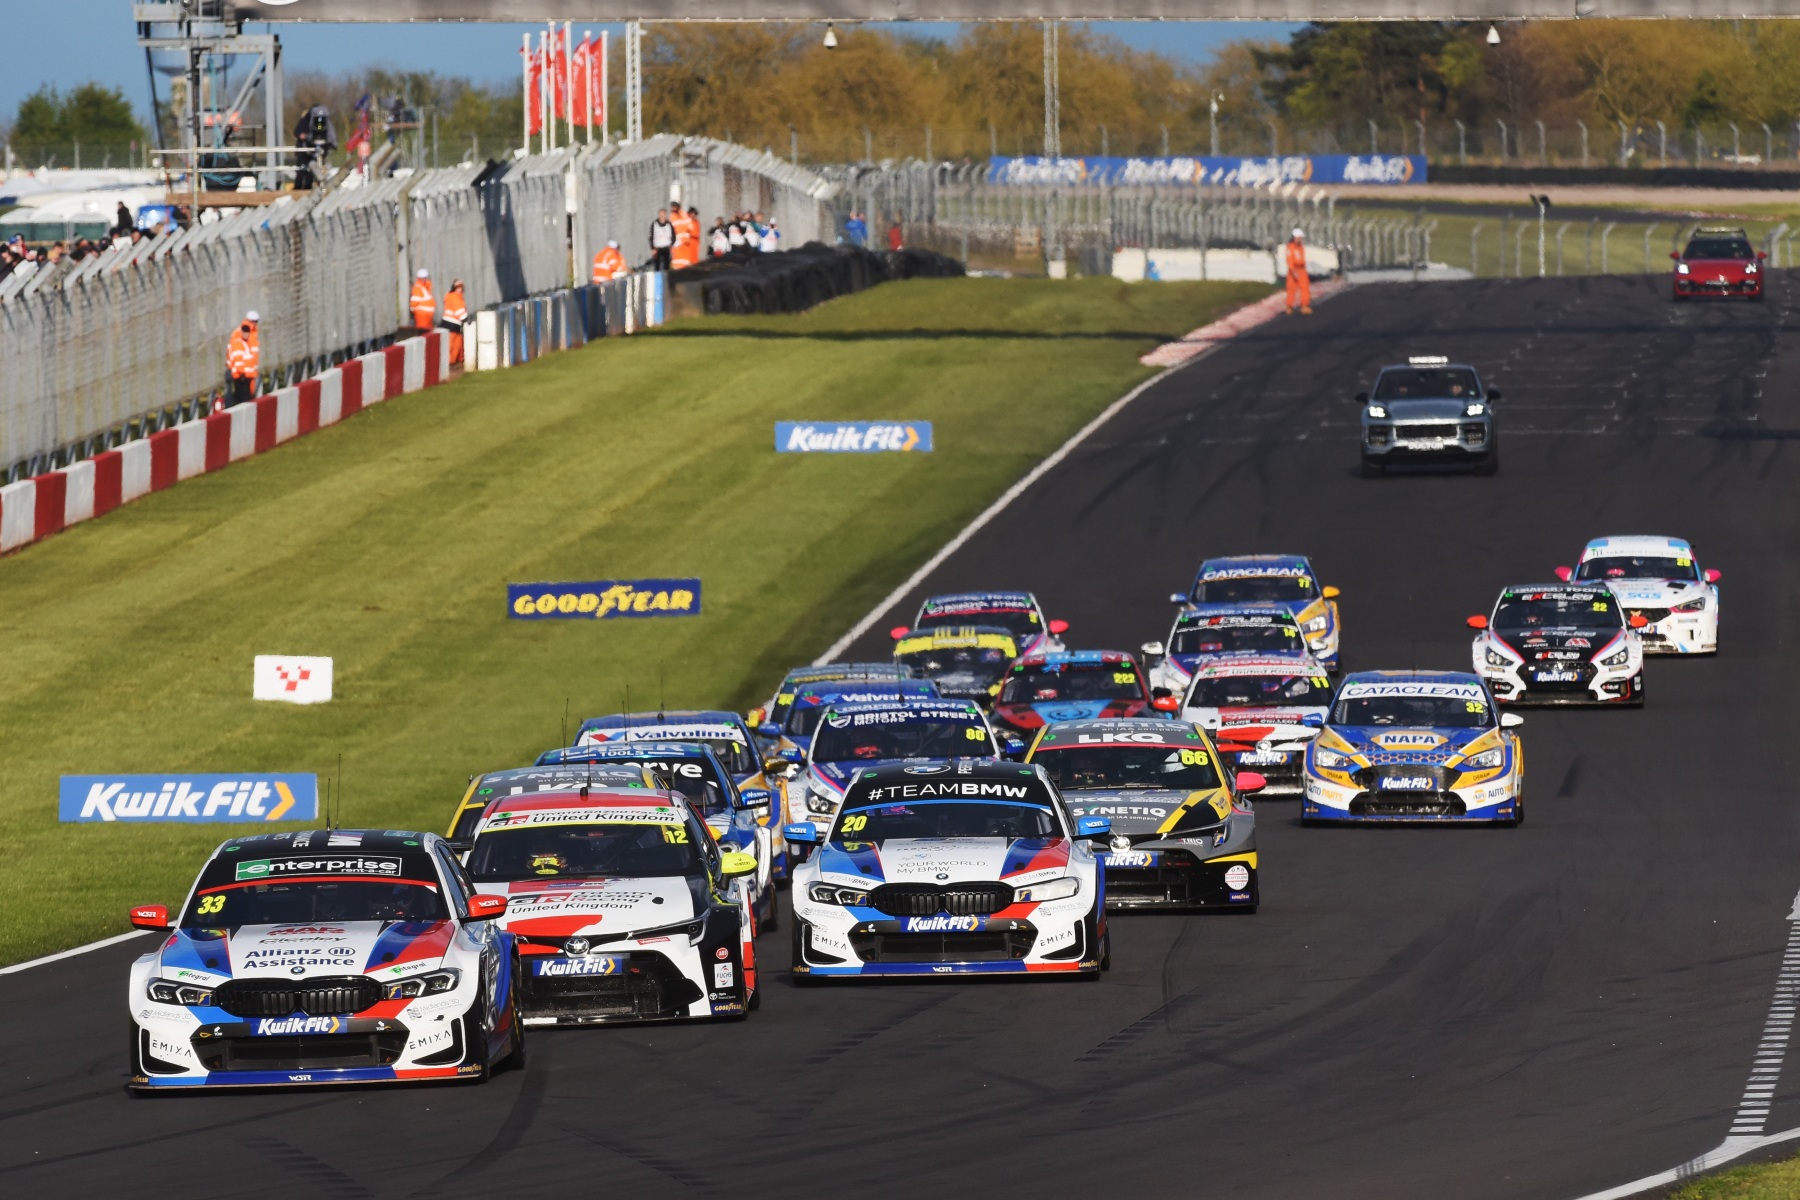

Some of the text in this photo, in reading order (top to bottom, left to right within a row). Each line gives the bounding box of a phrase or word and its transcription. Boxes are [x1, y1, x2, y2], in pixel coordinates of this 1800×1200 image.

[787, 426, 904, 451] KwikFit
[1204, 568, 1304, 580] CATACLEAN
[514, 585, 693, 617] GOODYEAR
[1592, 602, 1608, 612] 22
[1113, 672, 1135, 684] 222
[1310, 676, 1330, 688] 11
[1347, 686, 1479, 697] CATACLEAN
[1466, 702, 1484, 714] 32
[921, 711, 977, 720] STREET
[634, 730, 734, 739] Valvoline
[966, 728, 985, 741] 80
[1078, 732, 1166, 744] LKQ
[1384, 736, 1436, 744] NAPA
[1181, 750, 1208, 766] 66
[1382, 776, 1427, 790] KwikFit
[868, 784, 1028, 800] #TEAMBMW
[80, 782, 271, 821] KwikFit
[1073, 806, 1166, 817] SYNETIQ
[533, 814, 675, 823] United Kingdom
[841, 816, 868, 833] 20
[664, 831, 689, 844] 12
[245, 858, 398, 874] enterprise
[898, 860, 934, 868] YOUR
[198, 894, 226, 914] 33
[512, 902, 632, 914] United Kingdom
[908, 916, 972, 932] KwikFit
[244, 948, 322, 960] Allianz
[244, 958, 354, 970] Assistance
[540, 959, 606, 976] KwikFit
[258, 1016, 330, 1036] KwikFit
[409, 1032, 452, 1050] EMIXA
[152, 1040, 192, 1058] EMIXA
